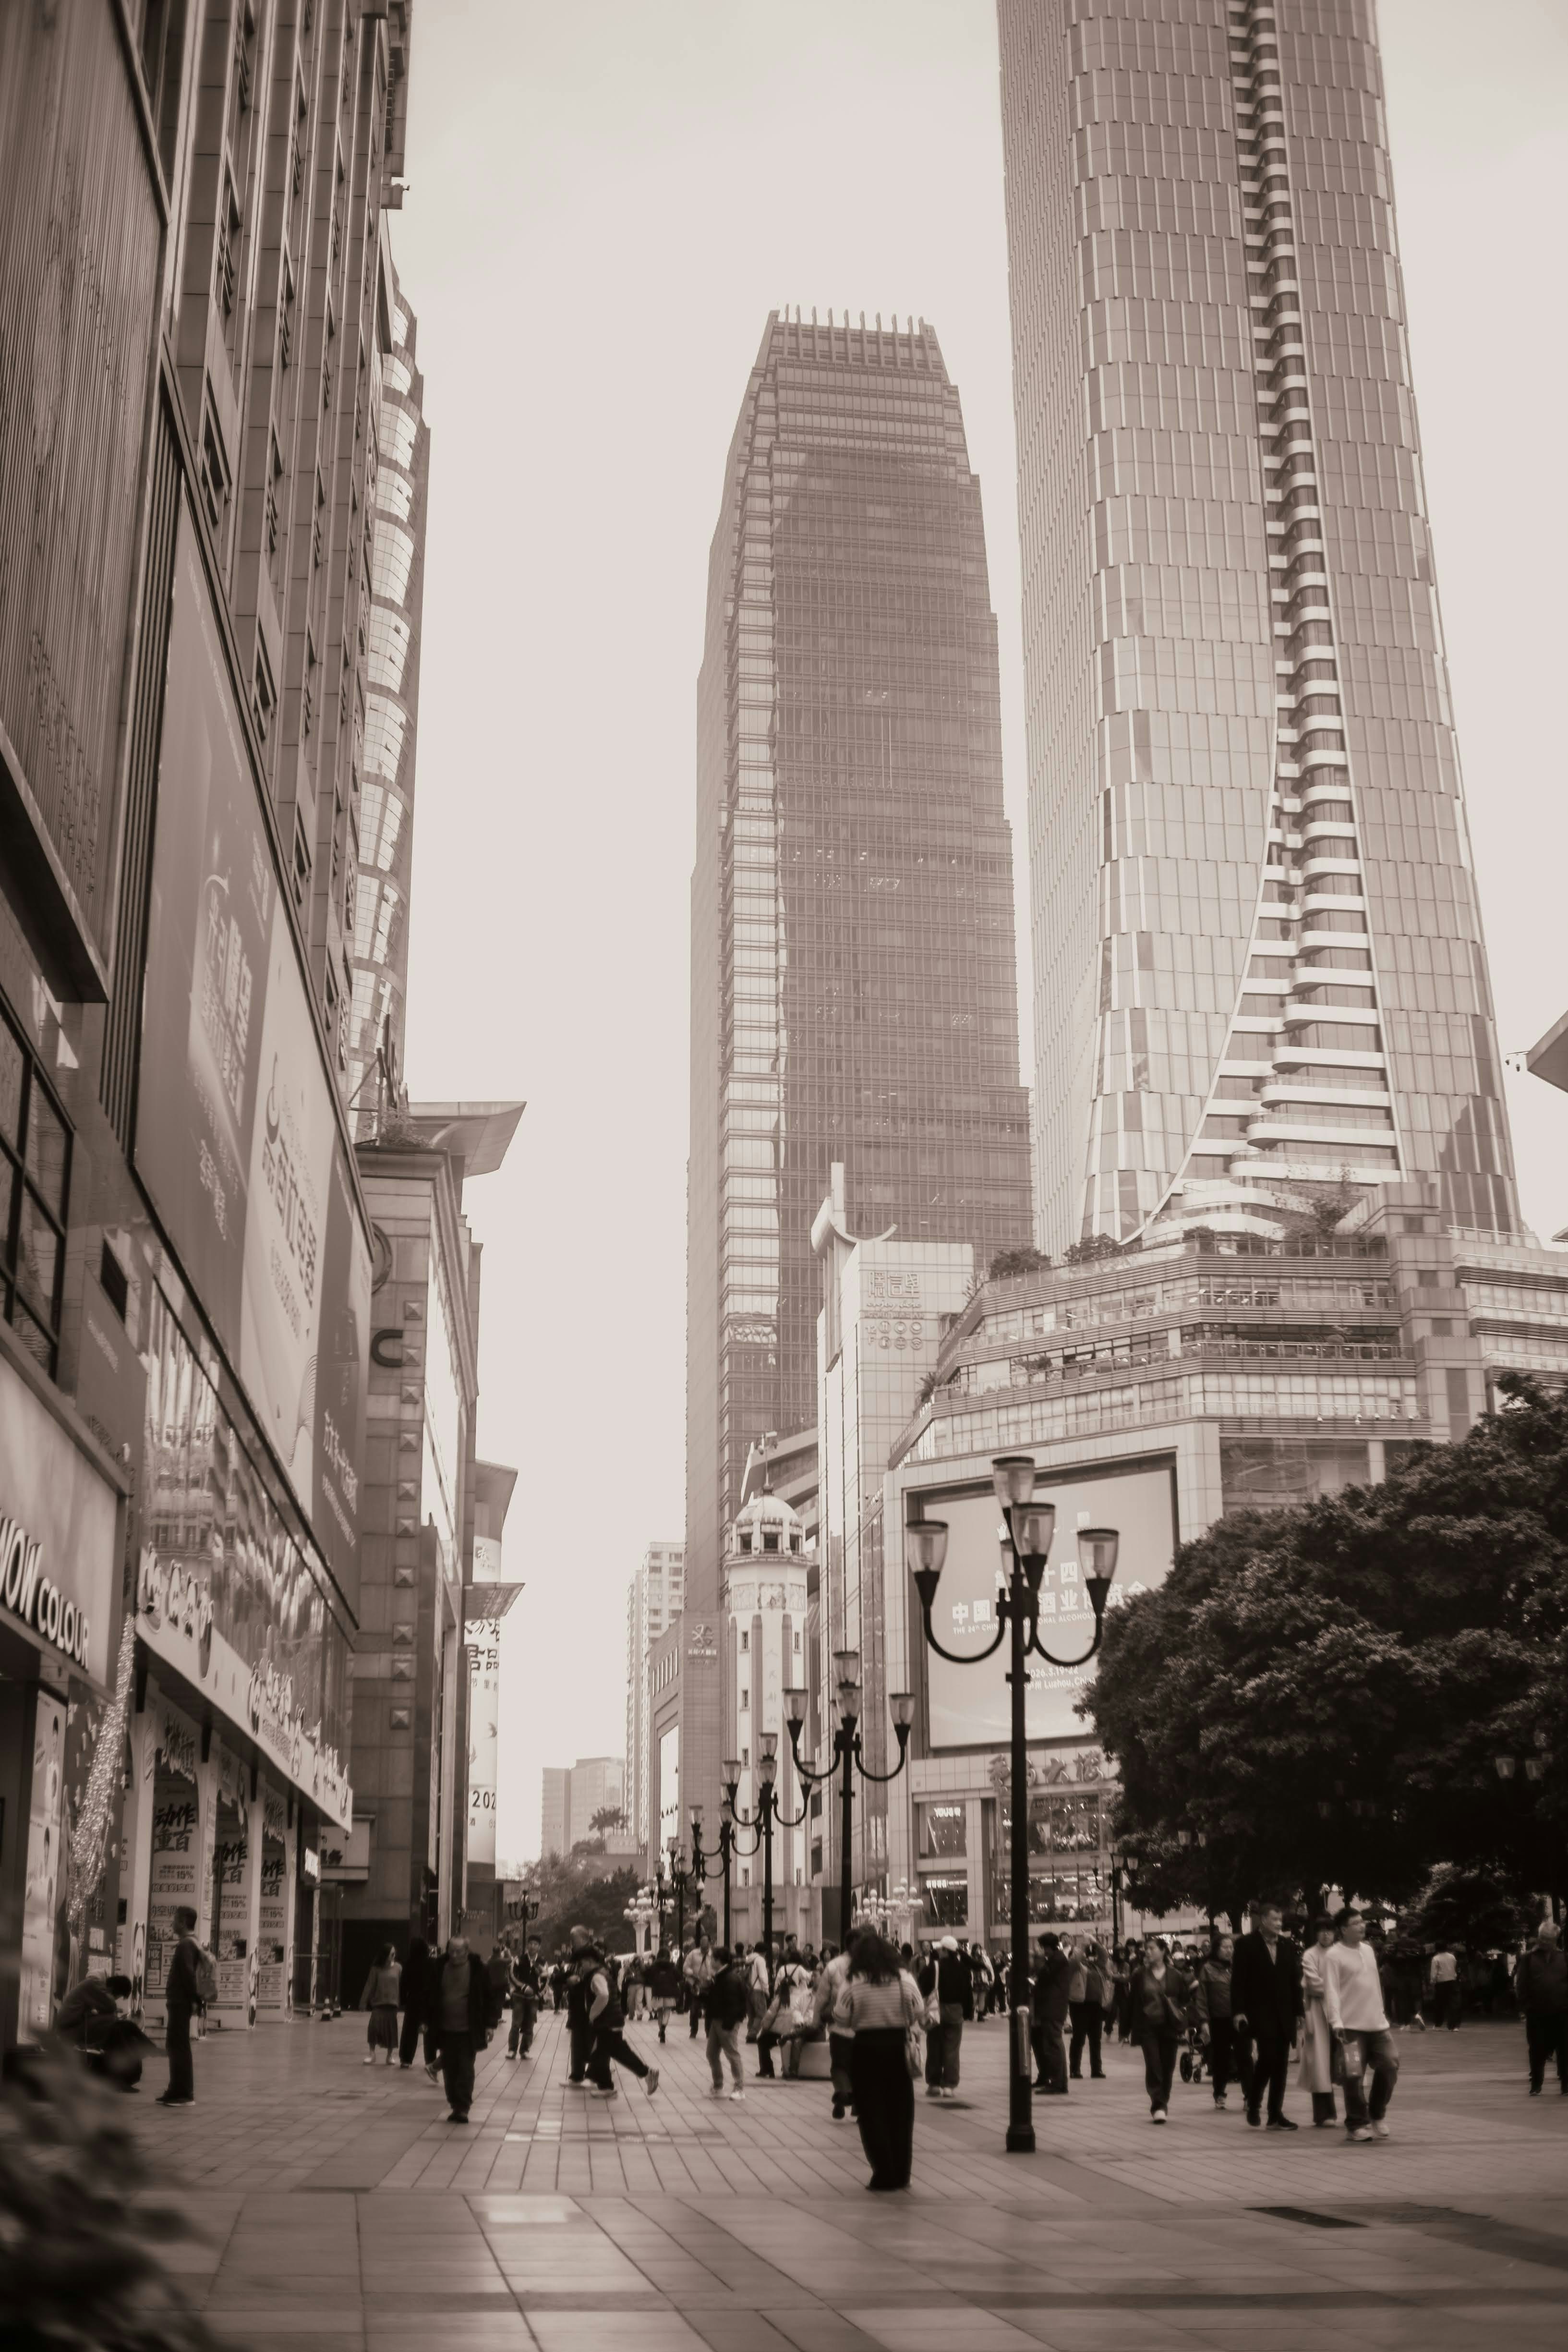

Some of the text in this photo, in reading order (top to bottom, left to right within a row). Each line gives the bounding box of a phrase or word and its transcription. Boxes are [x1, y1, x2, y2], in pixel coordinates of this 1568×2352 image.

[37, 1576, 89, 1670] COLOUR
[982, 1623, 999, 1632] CHIN
[1059, 1612, 1098, 1623] ALCOHOLI
[177, 1870, 193, 1879] 15%
